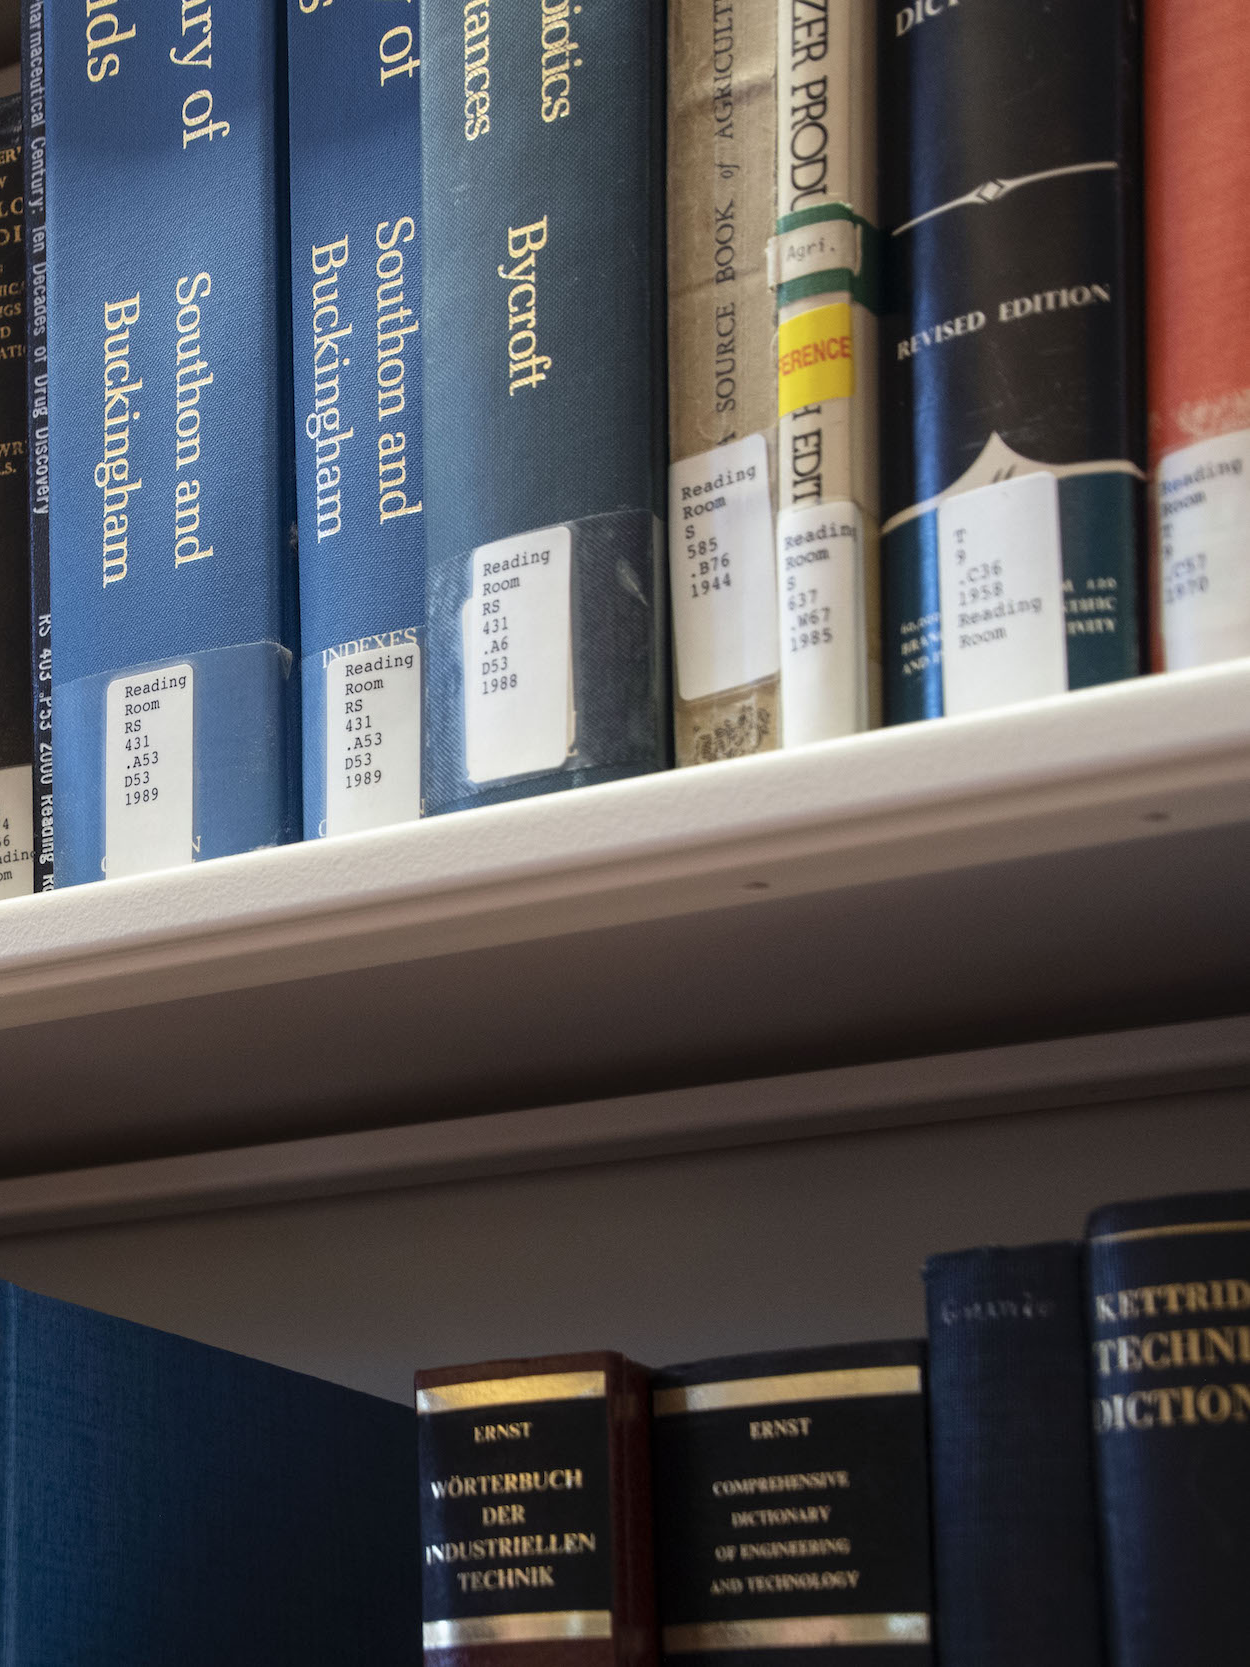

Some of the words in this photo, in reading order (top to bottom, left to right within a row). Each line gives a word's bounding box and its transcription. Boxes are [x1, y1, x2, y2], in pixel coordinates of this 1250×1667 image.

[181, 89, 230, 149] of
[29, 135, 46, 215] Century:
[720, 162, 740, 180] of
[714, 199, 735, 285] BOOK
[32, 261, 47, 336] Decades
[497, 214, 552, 397] Bycroft
[375, 216, 419, 422] Southon
[897, 310, 987, 360] REVISED
[998, 283, 1111, 323] EDITION
[715, 302, 736, 414] SOURCE
[175, 271, 214, 471] Southon
[33, 373, 49, 418] Drug
[306, 234, 354, 544] Buckingham
[94, 291, 143, 589] Buckingham
[33, 426, 49, 514] Discovery
[378, 432, 422, 525] and
[681, 464, 757, 501] Reading
[683, 494, 727, 521] Room
[175, 479, 214, 569] and
[685, 524, 696, 541] S
[687, 537, 719, 560] 585
[482, 549, 551, 577] Reading
[691, 553, 731, 579] .B76
[482, 576, 521, 597] Room
[691, 573, 732, 599] 1944
[482, 599, 500, 616] RS
[957, 596, 1042, 628] Reading
[482, 617, 509, 635] 431
[958, 627, 1007, 650] Room
[483, 636, 509, 655] .A6
[345, 653, 414, 677] Reading
[482, 656, 508, 676] D53
[125, 675, 187, 698] Reading
[345, 678, 385, 696] Room
[482, 673, 518, 695] 1988
[125, 699, 161, 716] Room
[345, 699, 363, 714] RS
[124, 719, 141, 734] RS
[345, 715, 372, 732] 431
[125, 735, 150, 751] 431
[346, 732, 383, 751] .A53
[126, 751, 159, 770] .A53
[345, 752, 372, 770] D53
[124, 771, 150, 788] D53
[345, 769, 382, 789] 1989
[125, 787, 159, 806] 1989
[40, 794, 54, 865] Reading
[473, 1421, 533, 1445] ERNST
[750, 1416, 812, 1440] ERNST
[431, 1467, 583, 1501] WÖRTERBUCH
[712, 1469, 850, 1498] COMPREHENSIVE
[481, 1503, 526, 1527] DER
[731, 1504, 832, 1529] DICTIONARY
[425, 1532, 596, 1567] INDUSTRIELLEN
[715, 1544, 737, 1563] OF
[740, 1536, 851, 1562] ENGINEERING
[457, 1565, 555, 1594] TECHNIK
[710, 1576, 744, 1597] AND
[746, 1570, 861, 1596] TECHNOLOGY
